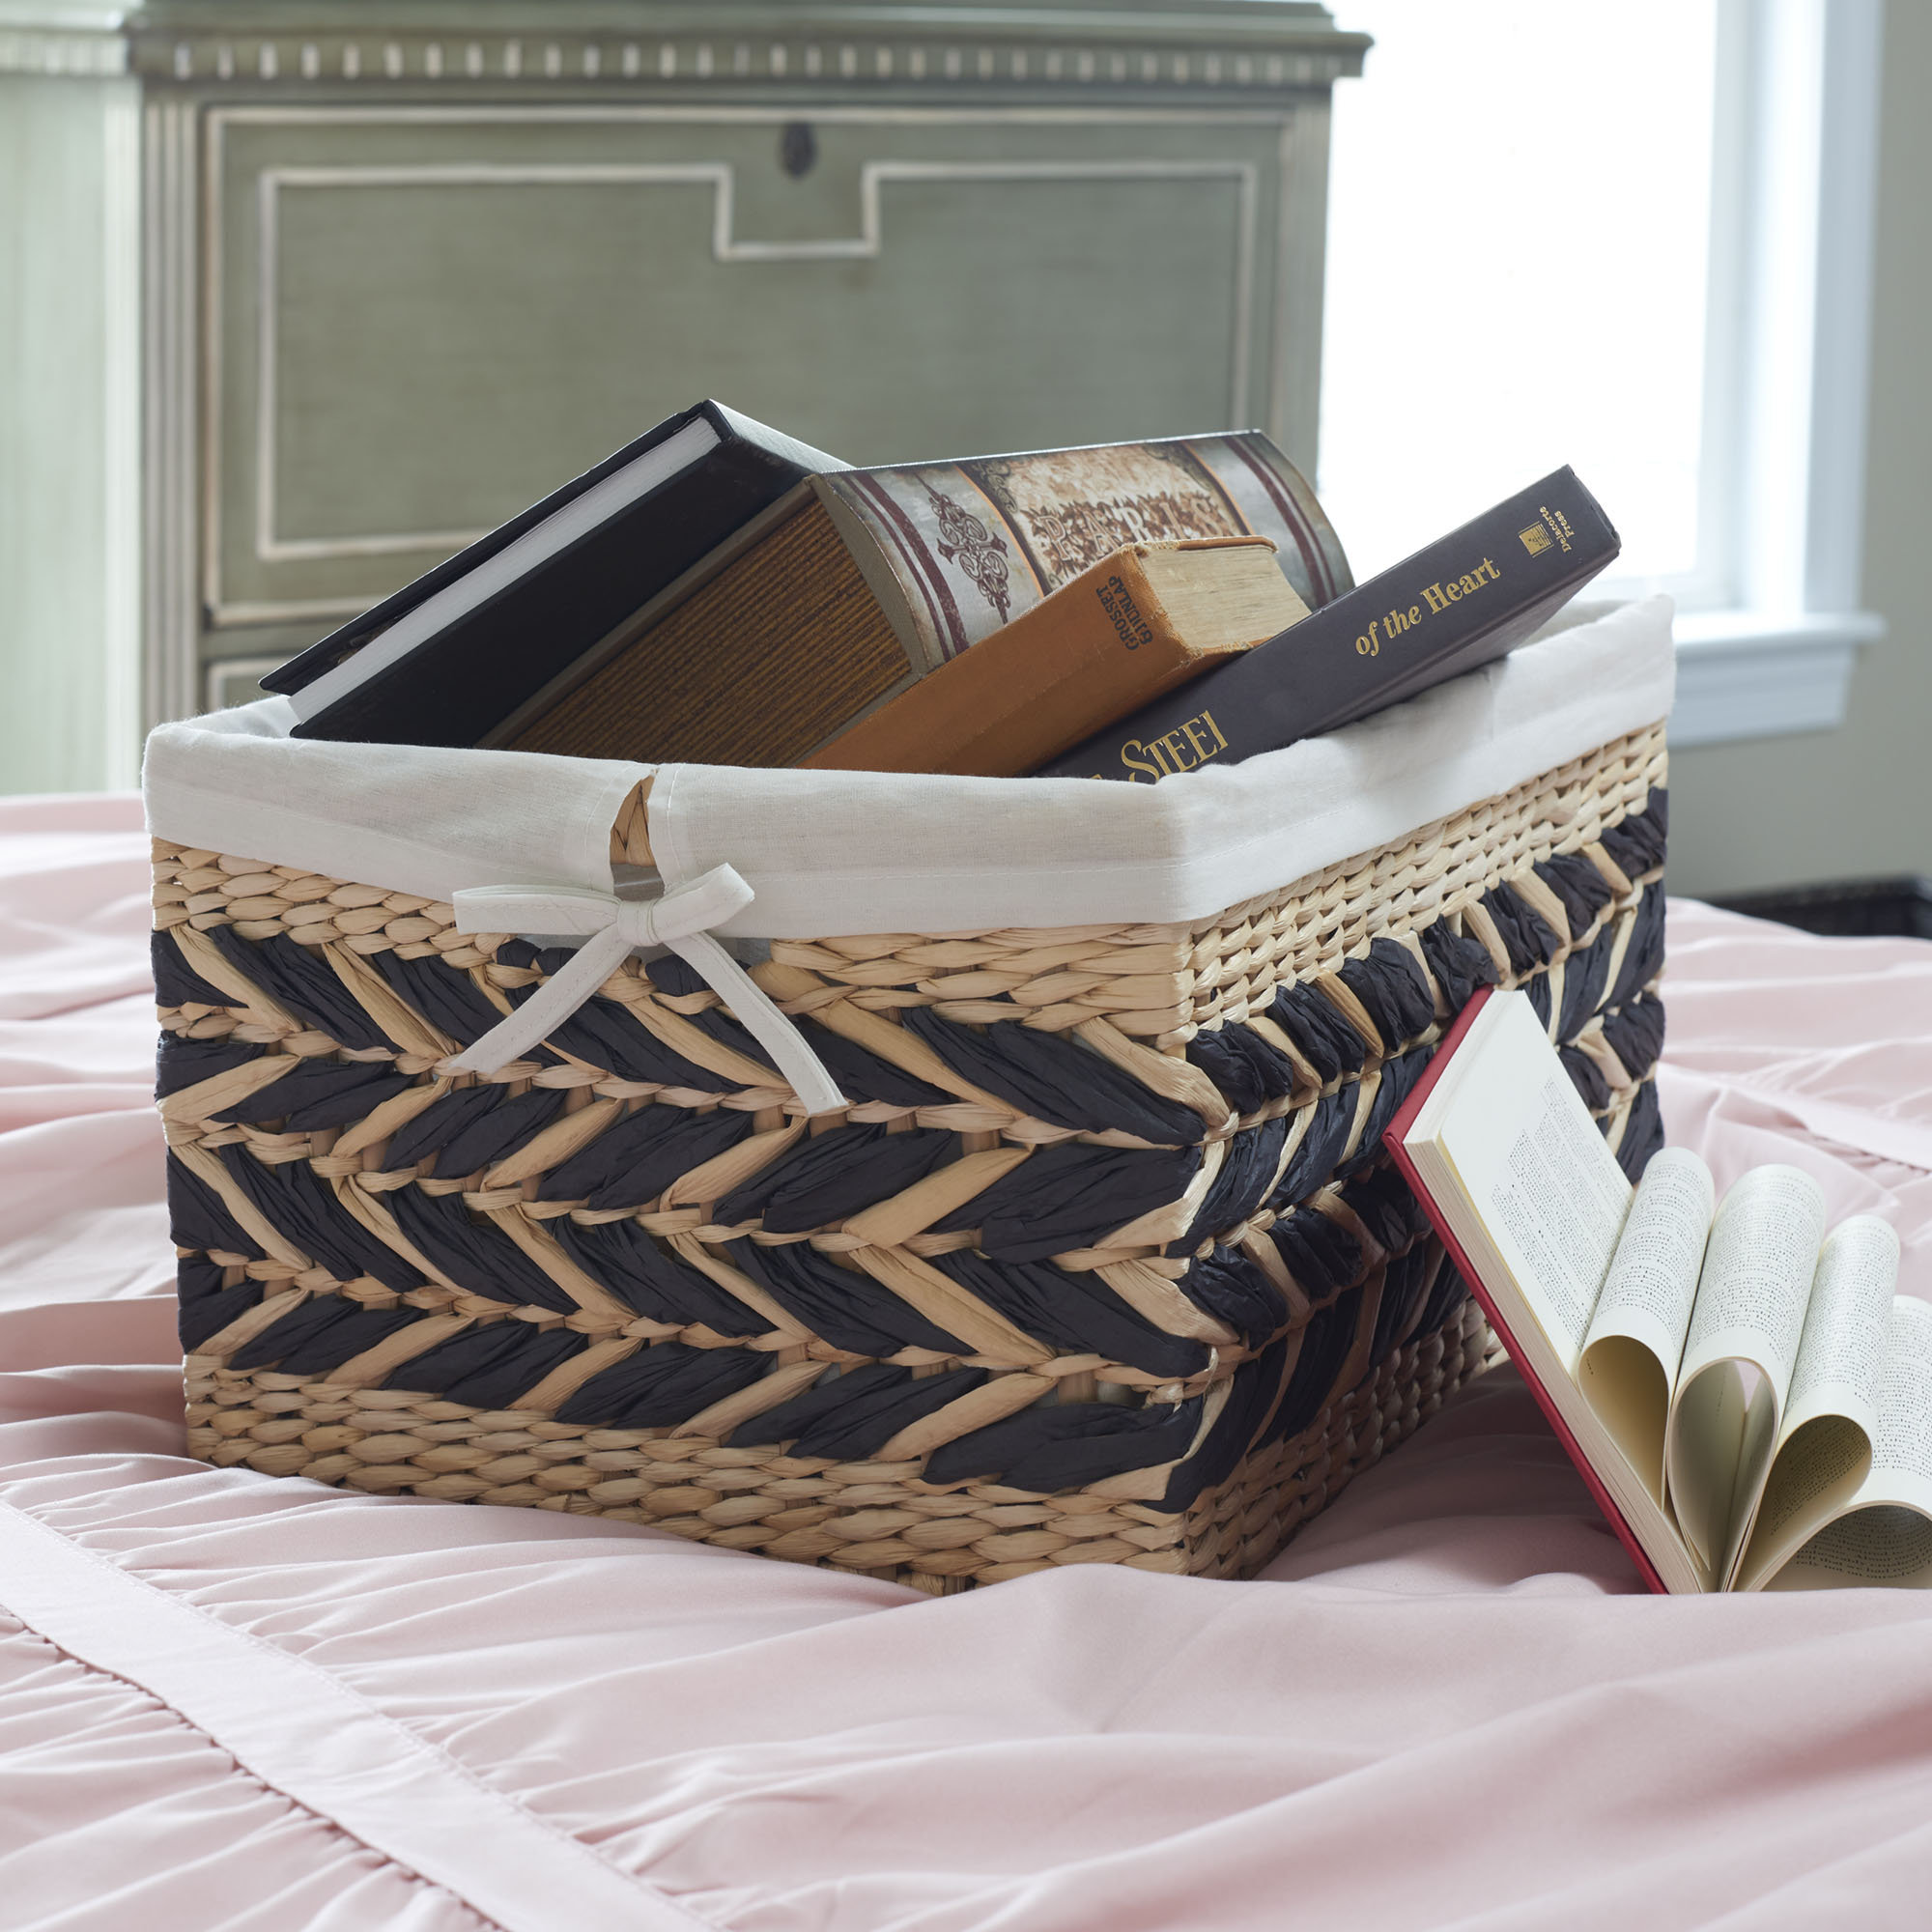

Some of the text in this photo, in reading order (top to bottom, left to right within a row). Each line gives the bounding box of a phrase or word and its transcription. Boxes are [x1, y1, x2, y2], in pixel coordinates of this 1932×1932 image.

[1036, 495, 1225, 562] PARIS
[1539, 506, 1572, 553] Delacorte
[1554, 510, 1575, 538] Press
[1096, 584, 1140, 650] GROSSET
[1355, 556, 1501, 657] of the Heart
